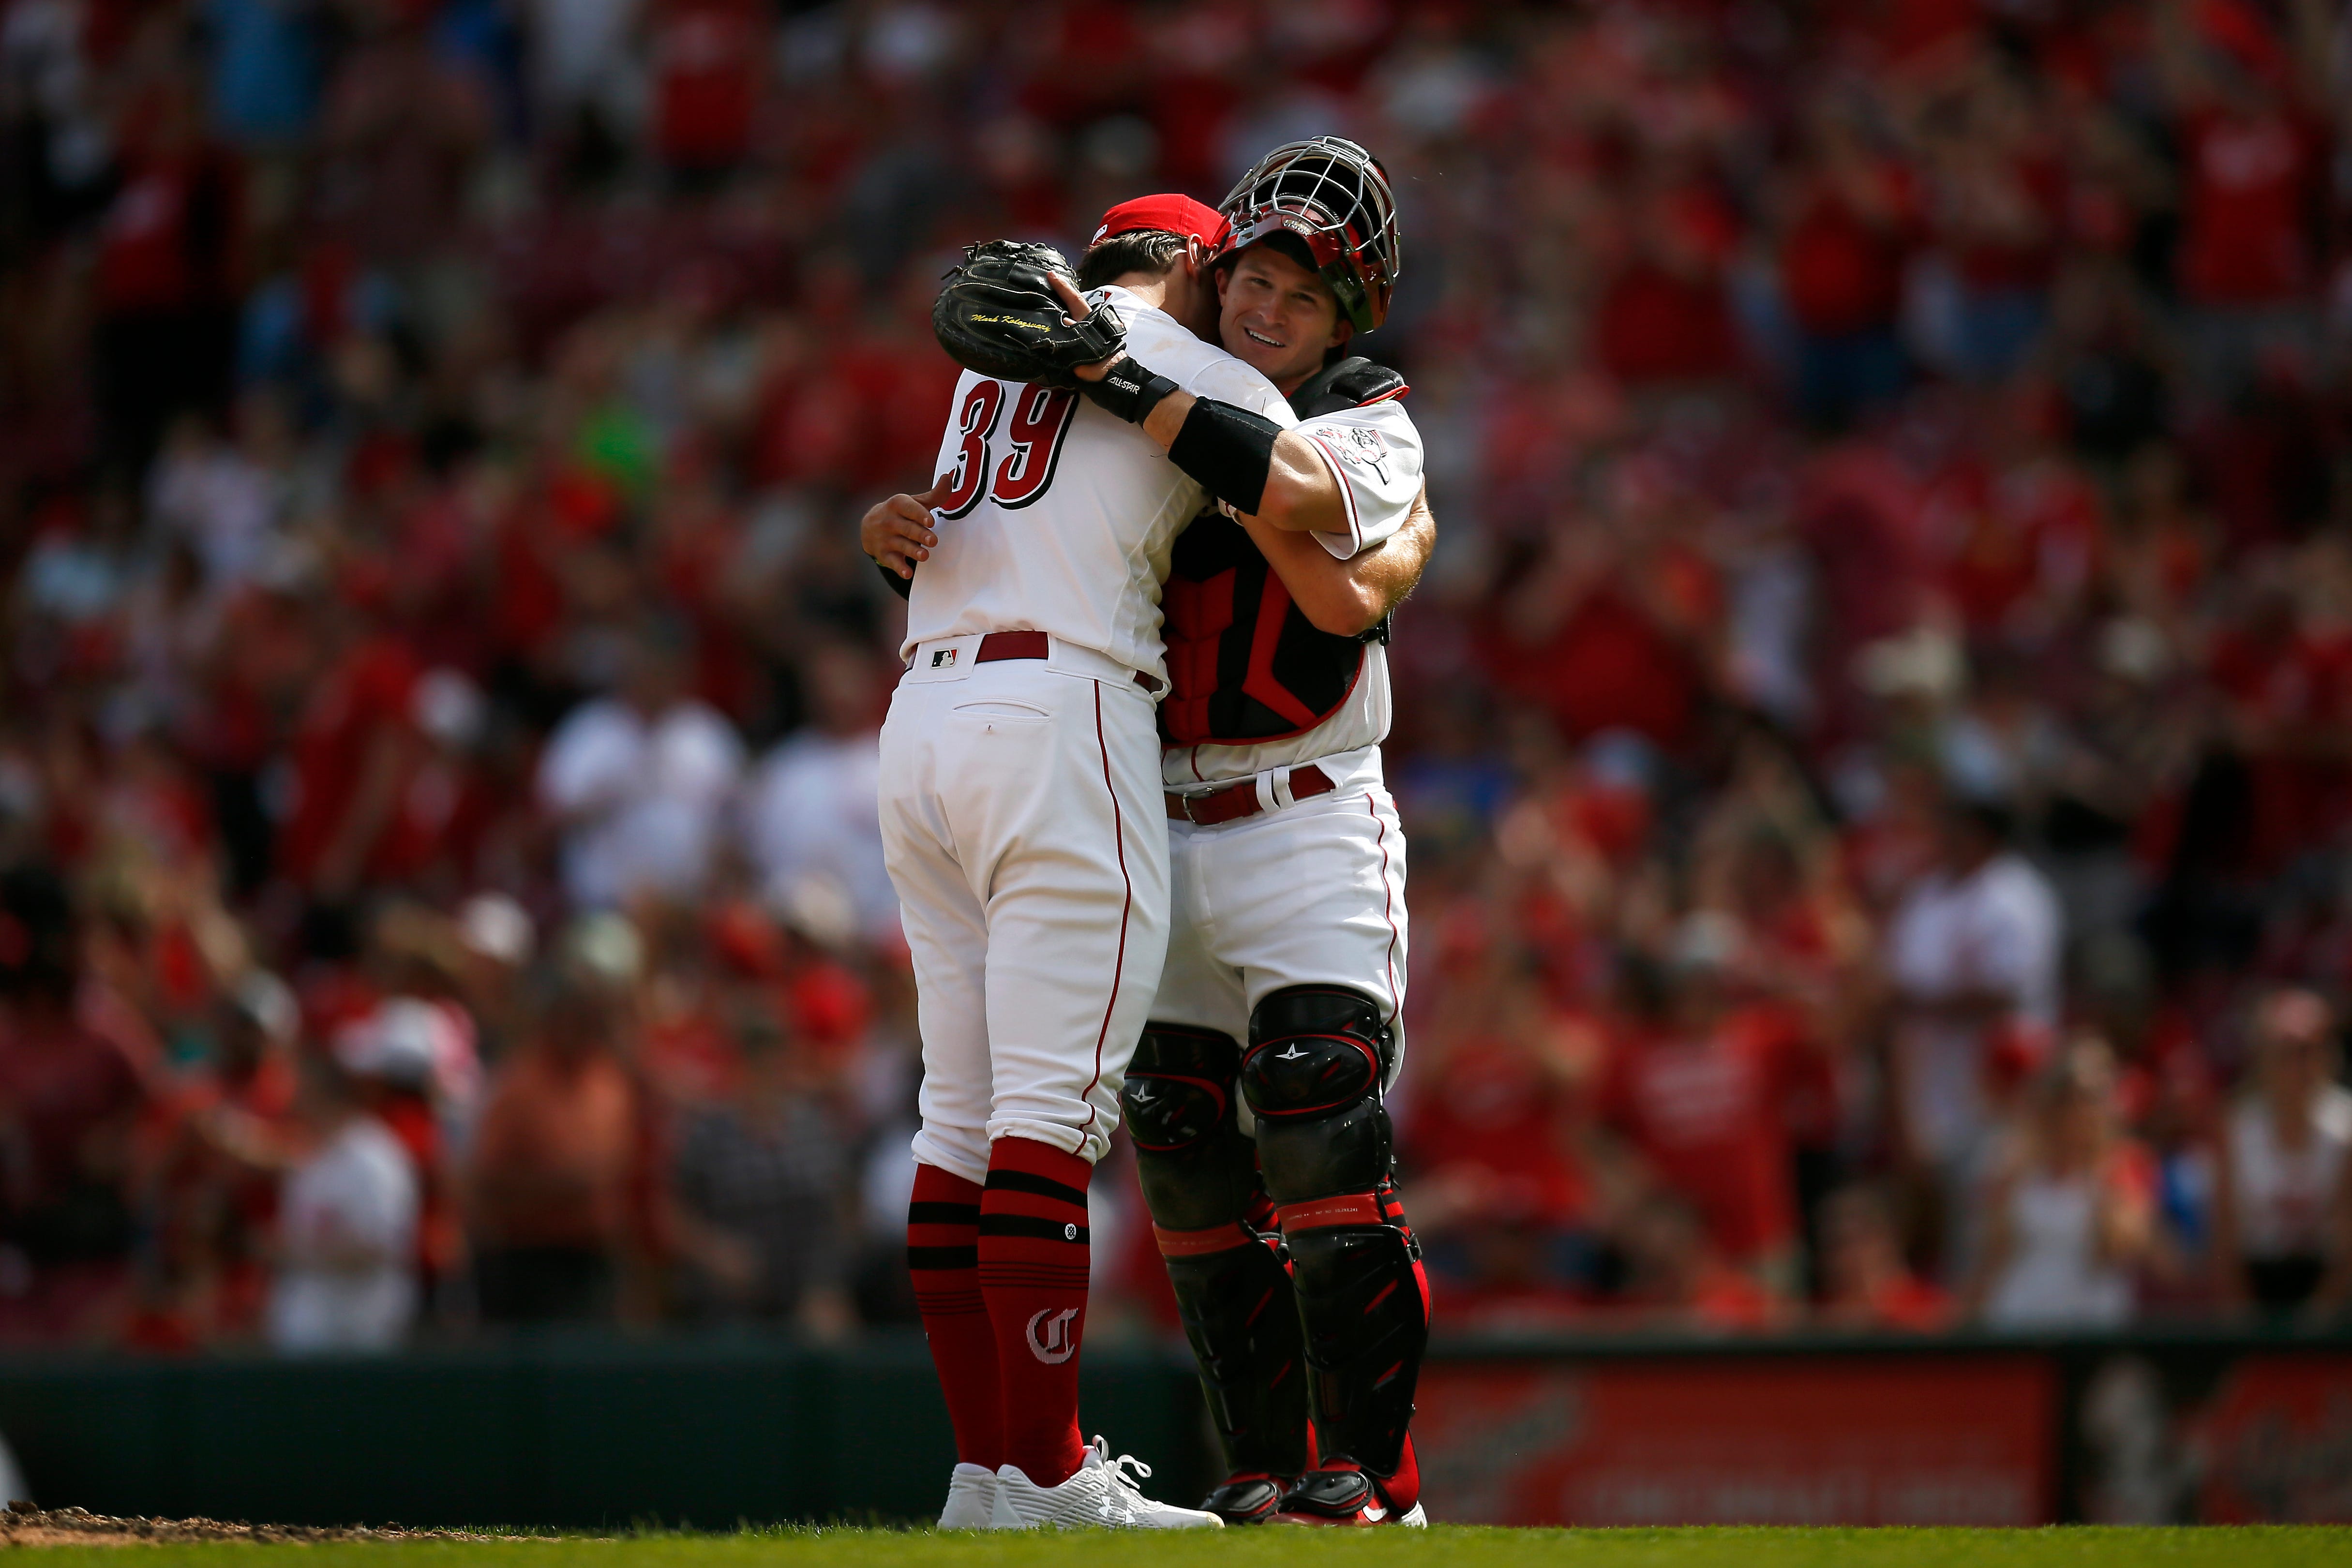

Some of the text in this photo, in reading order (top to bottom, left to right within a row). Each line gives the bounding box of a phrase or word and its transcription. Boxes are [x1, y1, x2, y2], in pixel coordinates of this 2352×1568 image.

[1283, 223, 1309, 237] VISION
[971, 314, 1000, 322] Mark
[1107, 376, 1140, 395] ALL-STAR
[937, 380, 1079, 521] 39
